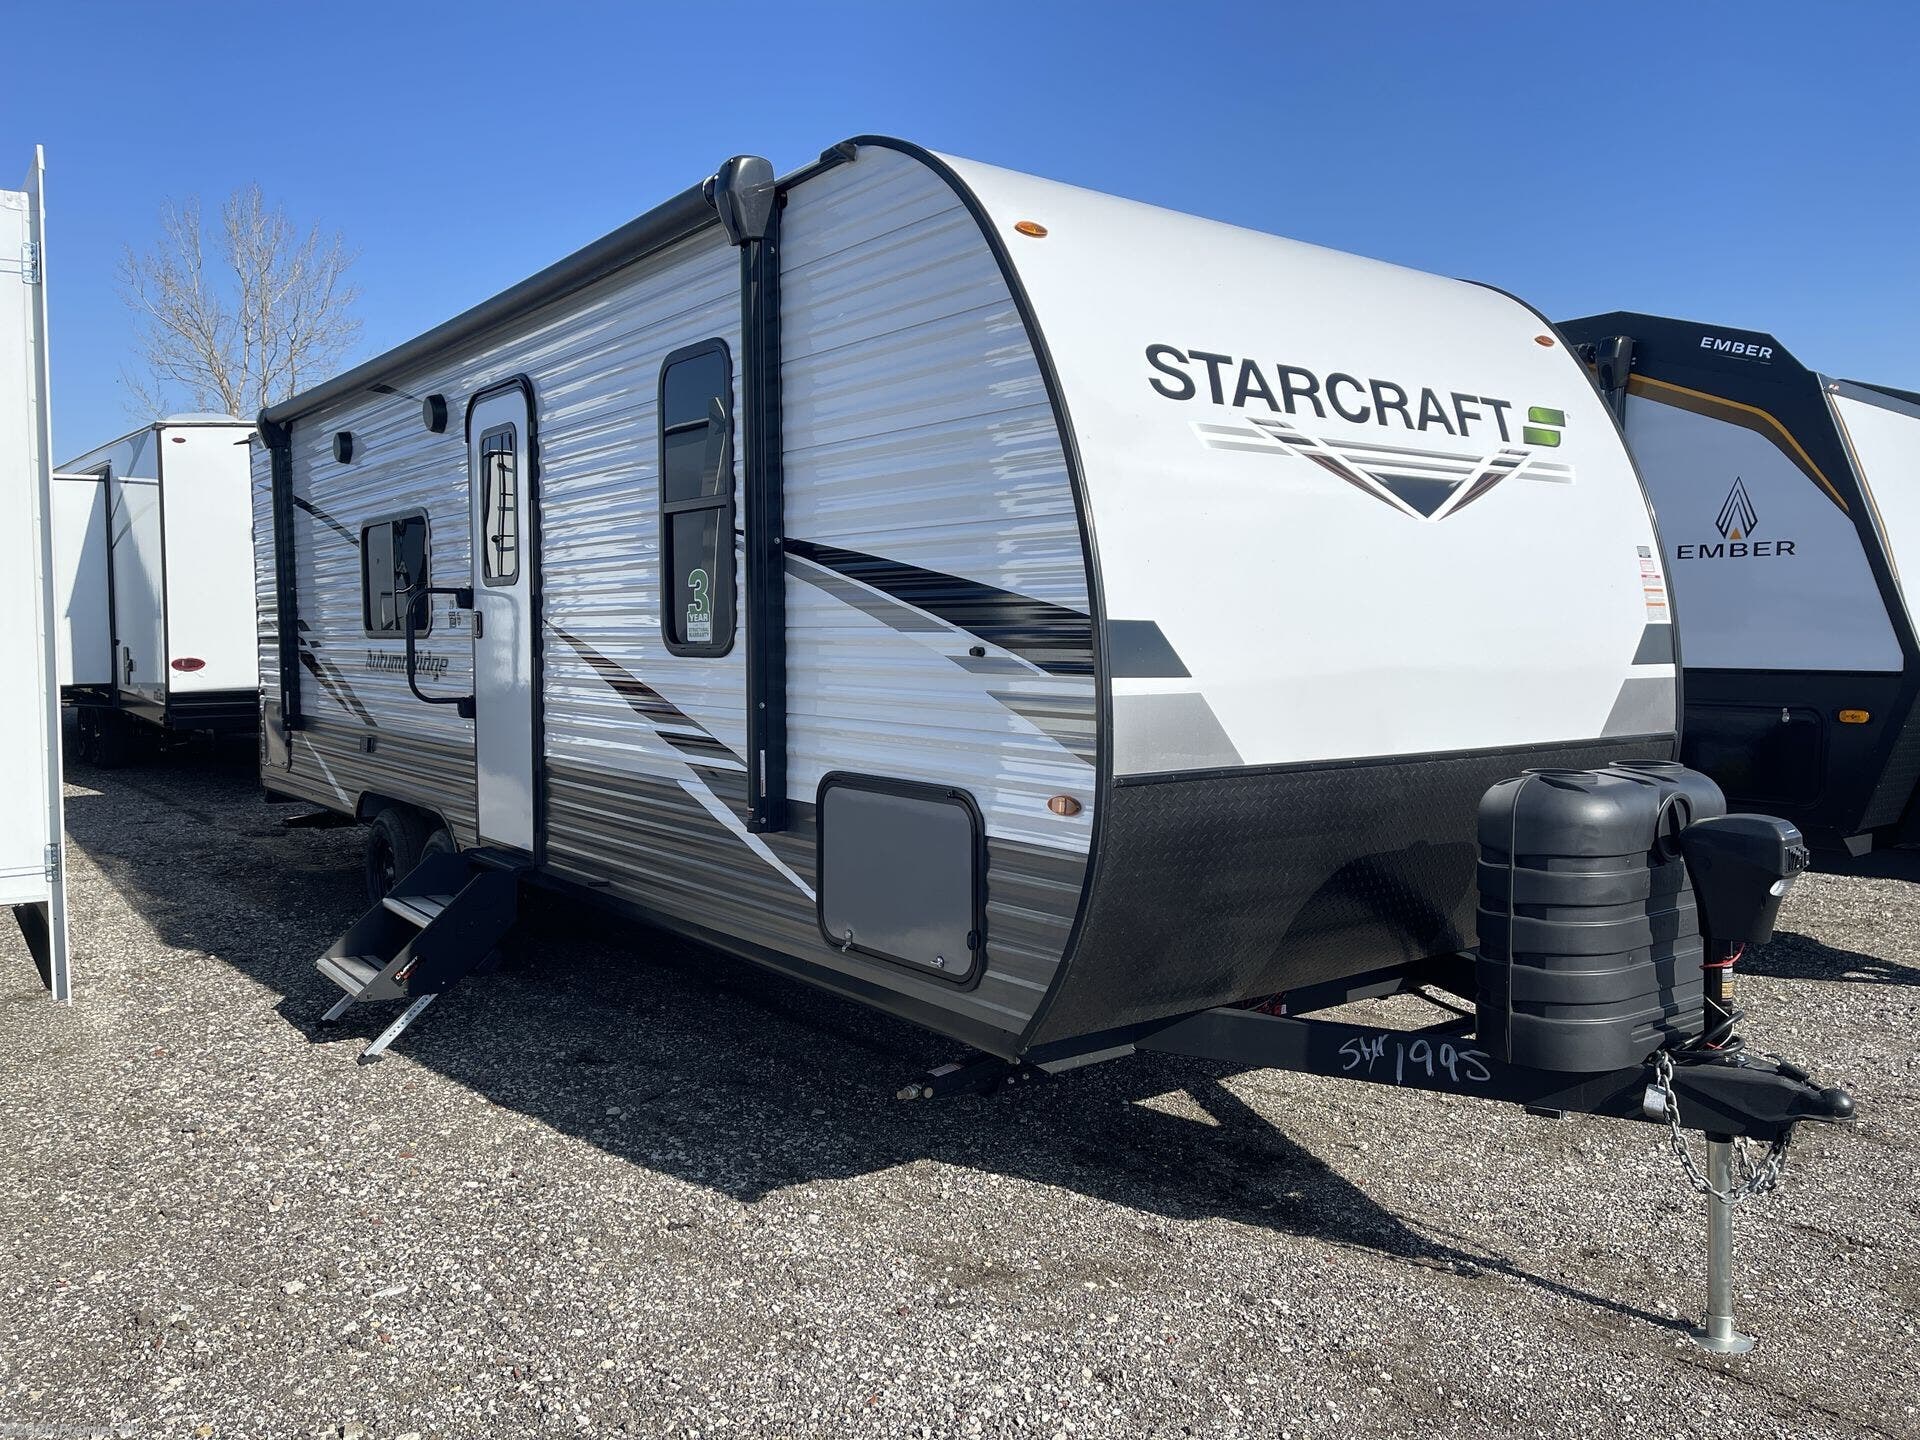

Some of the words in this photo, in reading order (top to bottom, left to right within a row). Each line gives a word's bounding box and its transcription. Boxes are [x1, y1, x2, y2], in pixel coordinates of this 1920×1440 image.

[1700, 336, 1773, 359] EMBER
[1145, 343, 1513, 442] STARCRAFT
[1676, 540, 1796, 560] EMBER
[687, 568, 710, 613] 3
[689, 613, 709, 622] YEAR
[1396, 1039, 1492, 1085] 1995
